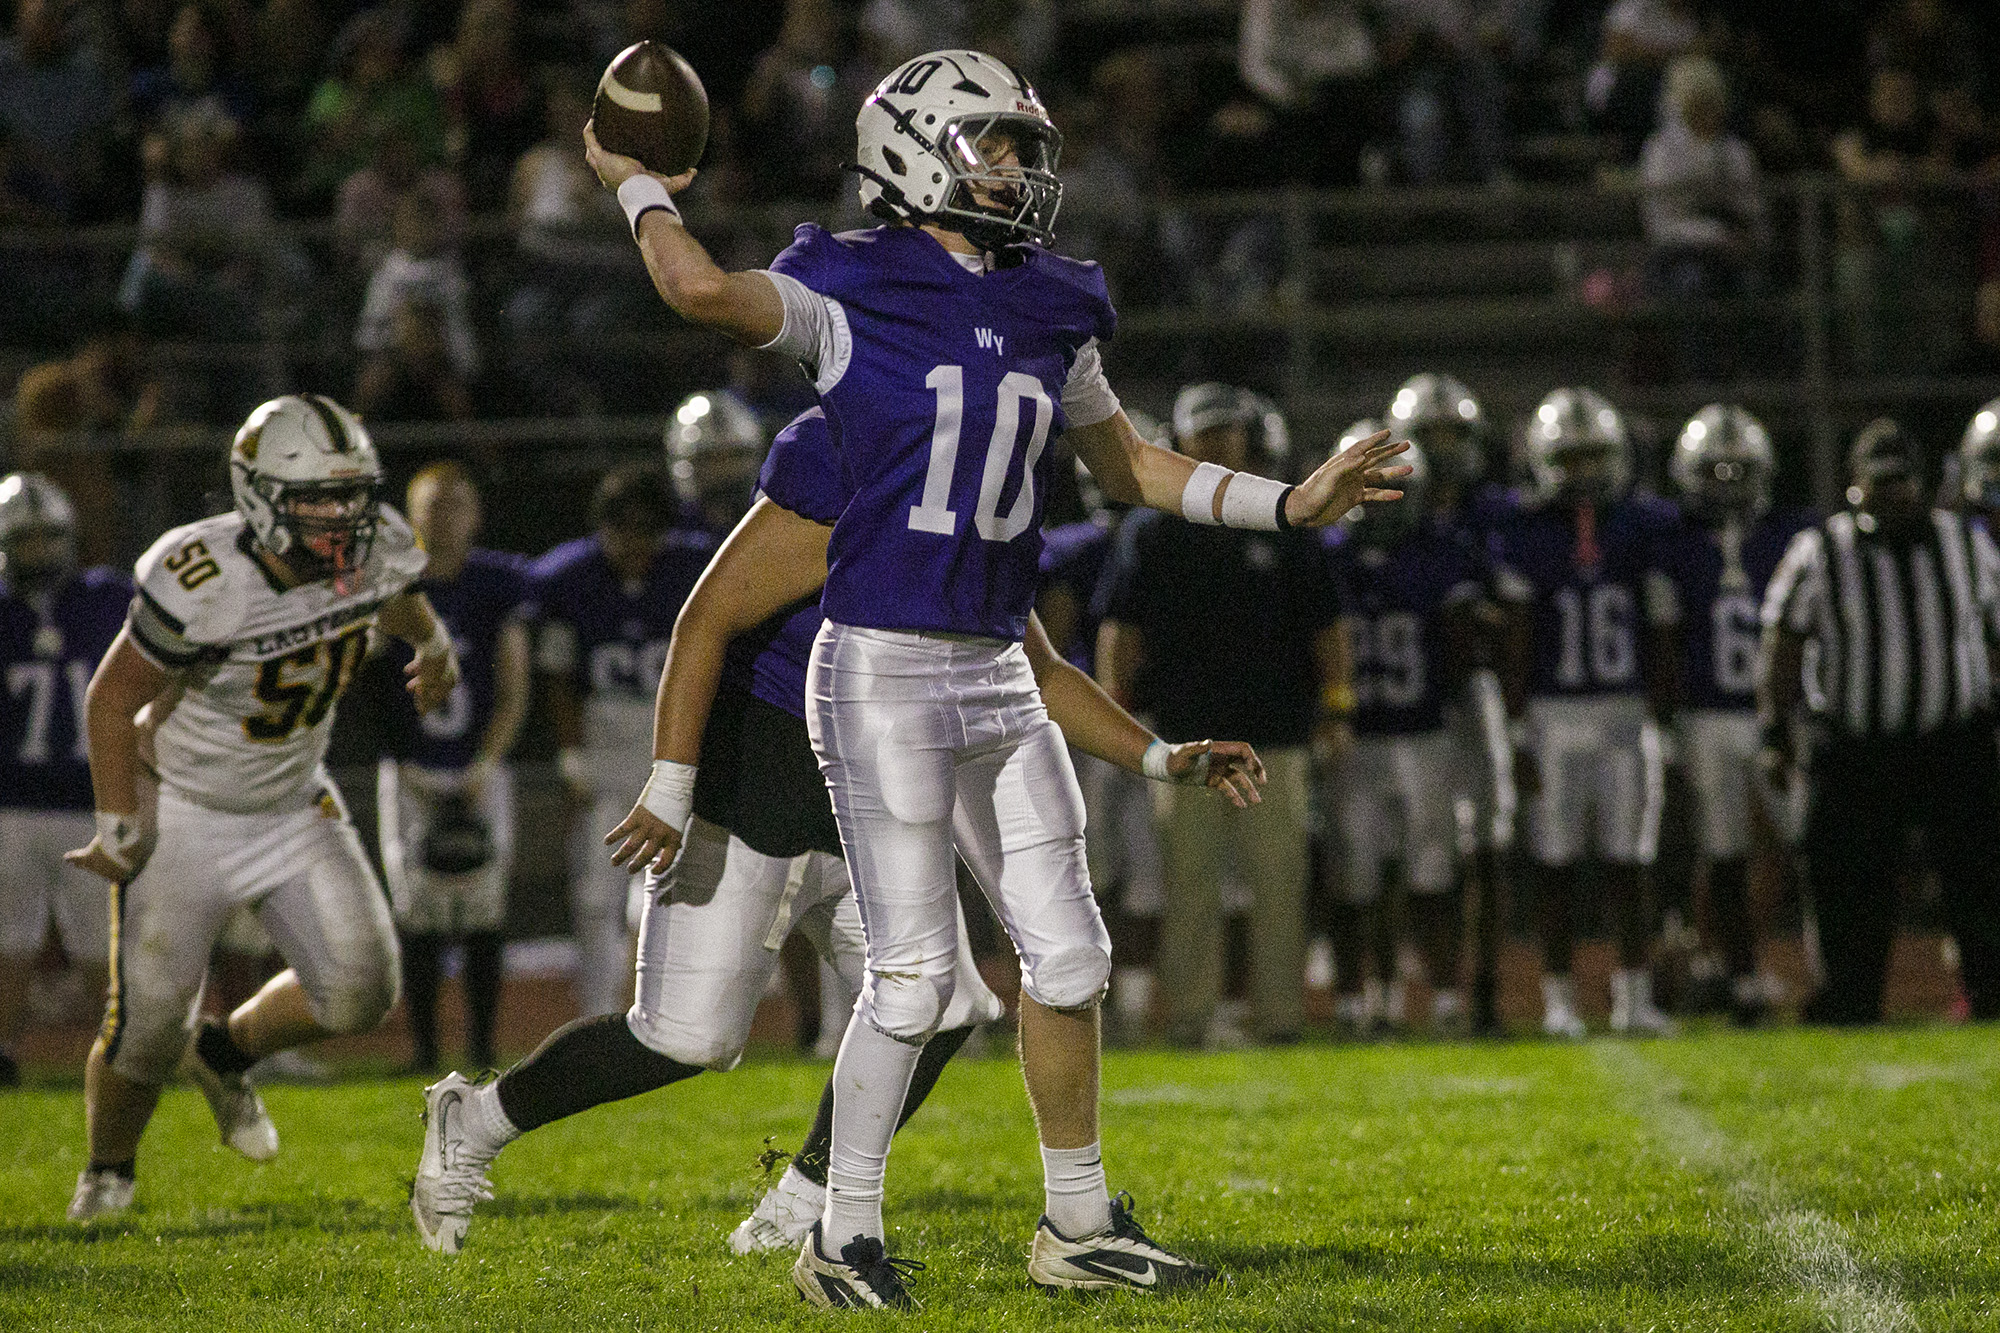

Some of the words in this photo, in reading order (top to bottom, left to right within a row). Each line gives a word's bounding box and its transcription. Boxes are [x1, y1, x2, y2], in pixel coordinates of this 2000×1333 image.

[886, 60, 943, 95] 10
[974, 327, 1004, 356] WY
[908, 365, 1053, 543] 10
[164, 540, 221, 591] 50
[1554, 582, 1639, 685] 16
[241, 621, 370, 742] 50
